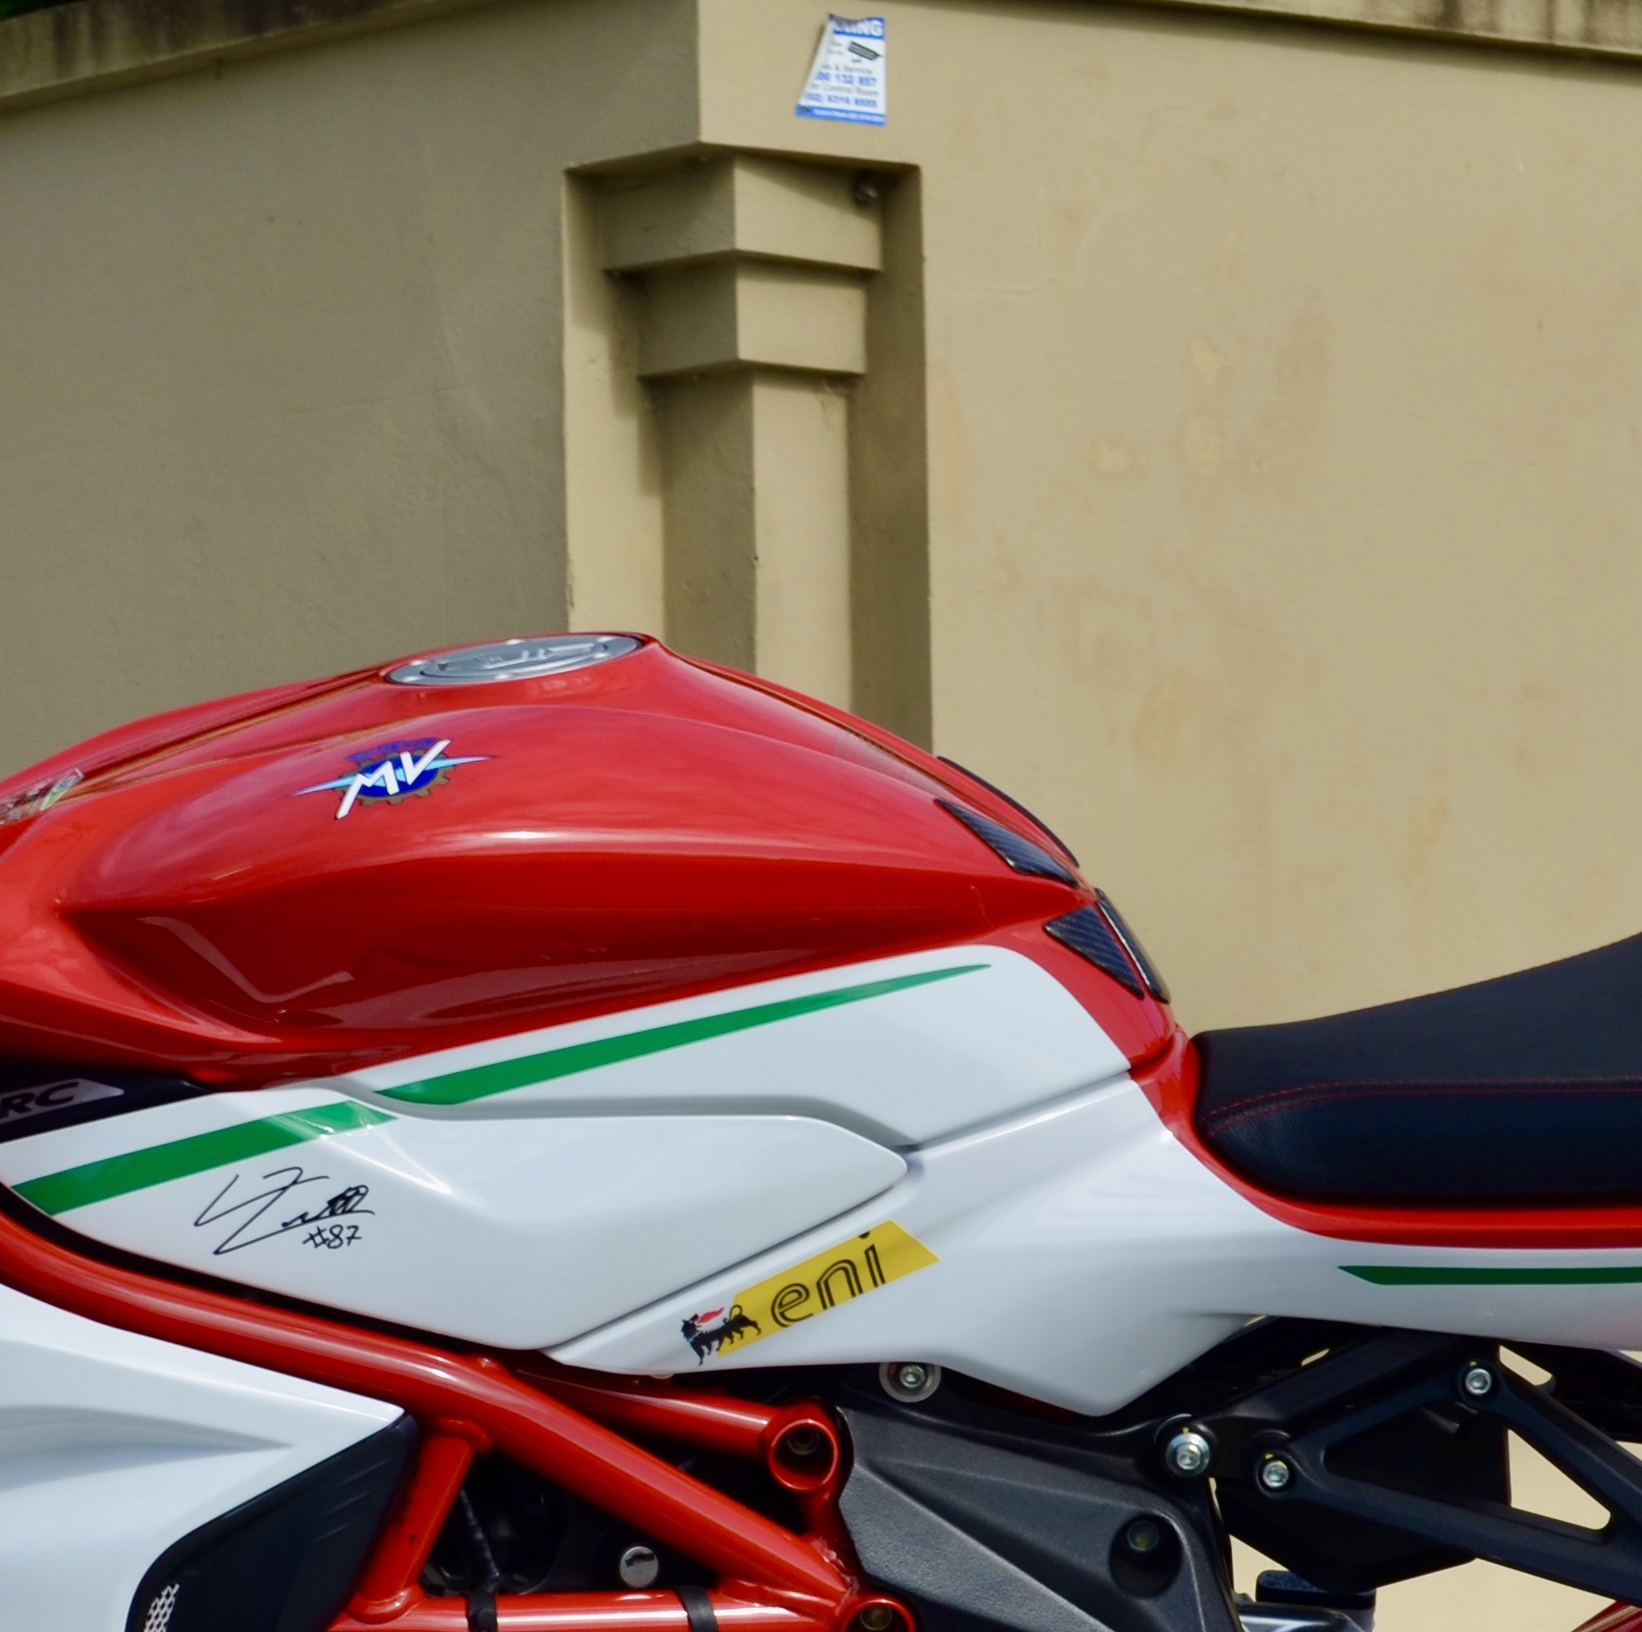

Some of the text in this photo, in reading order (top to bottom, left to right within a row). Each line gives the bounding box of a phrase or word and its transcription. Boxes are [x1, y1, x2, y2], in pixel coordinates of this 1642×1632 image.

[335, 738, 451, 820] MV
[301, 1224, 362, 1250] #87
[770, 1230, 887, 1329] eni
